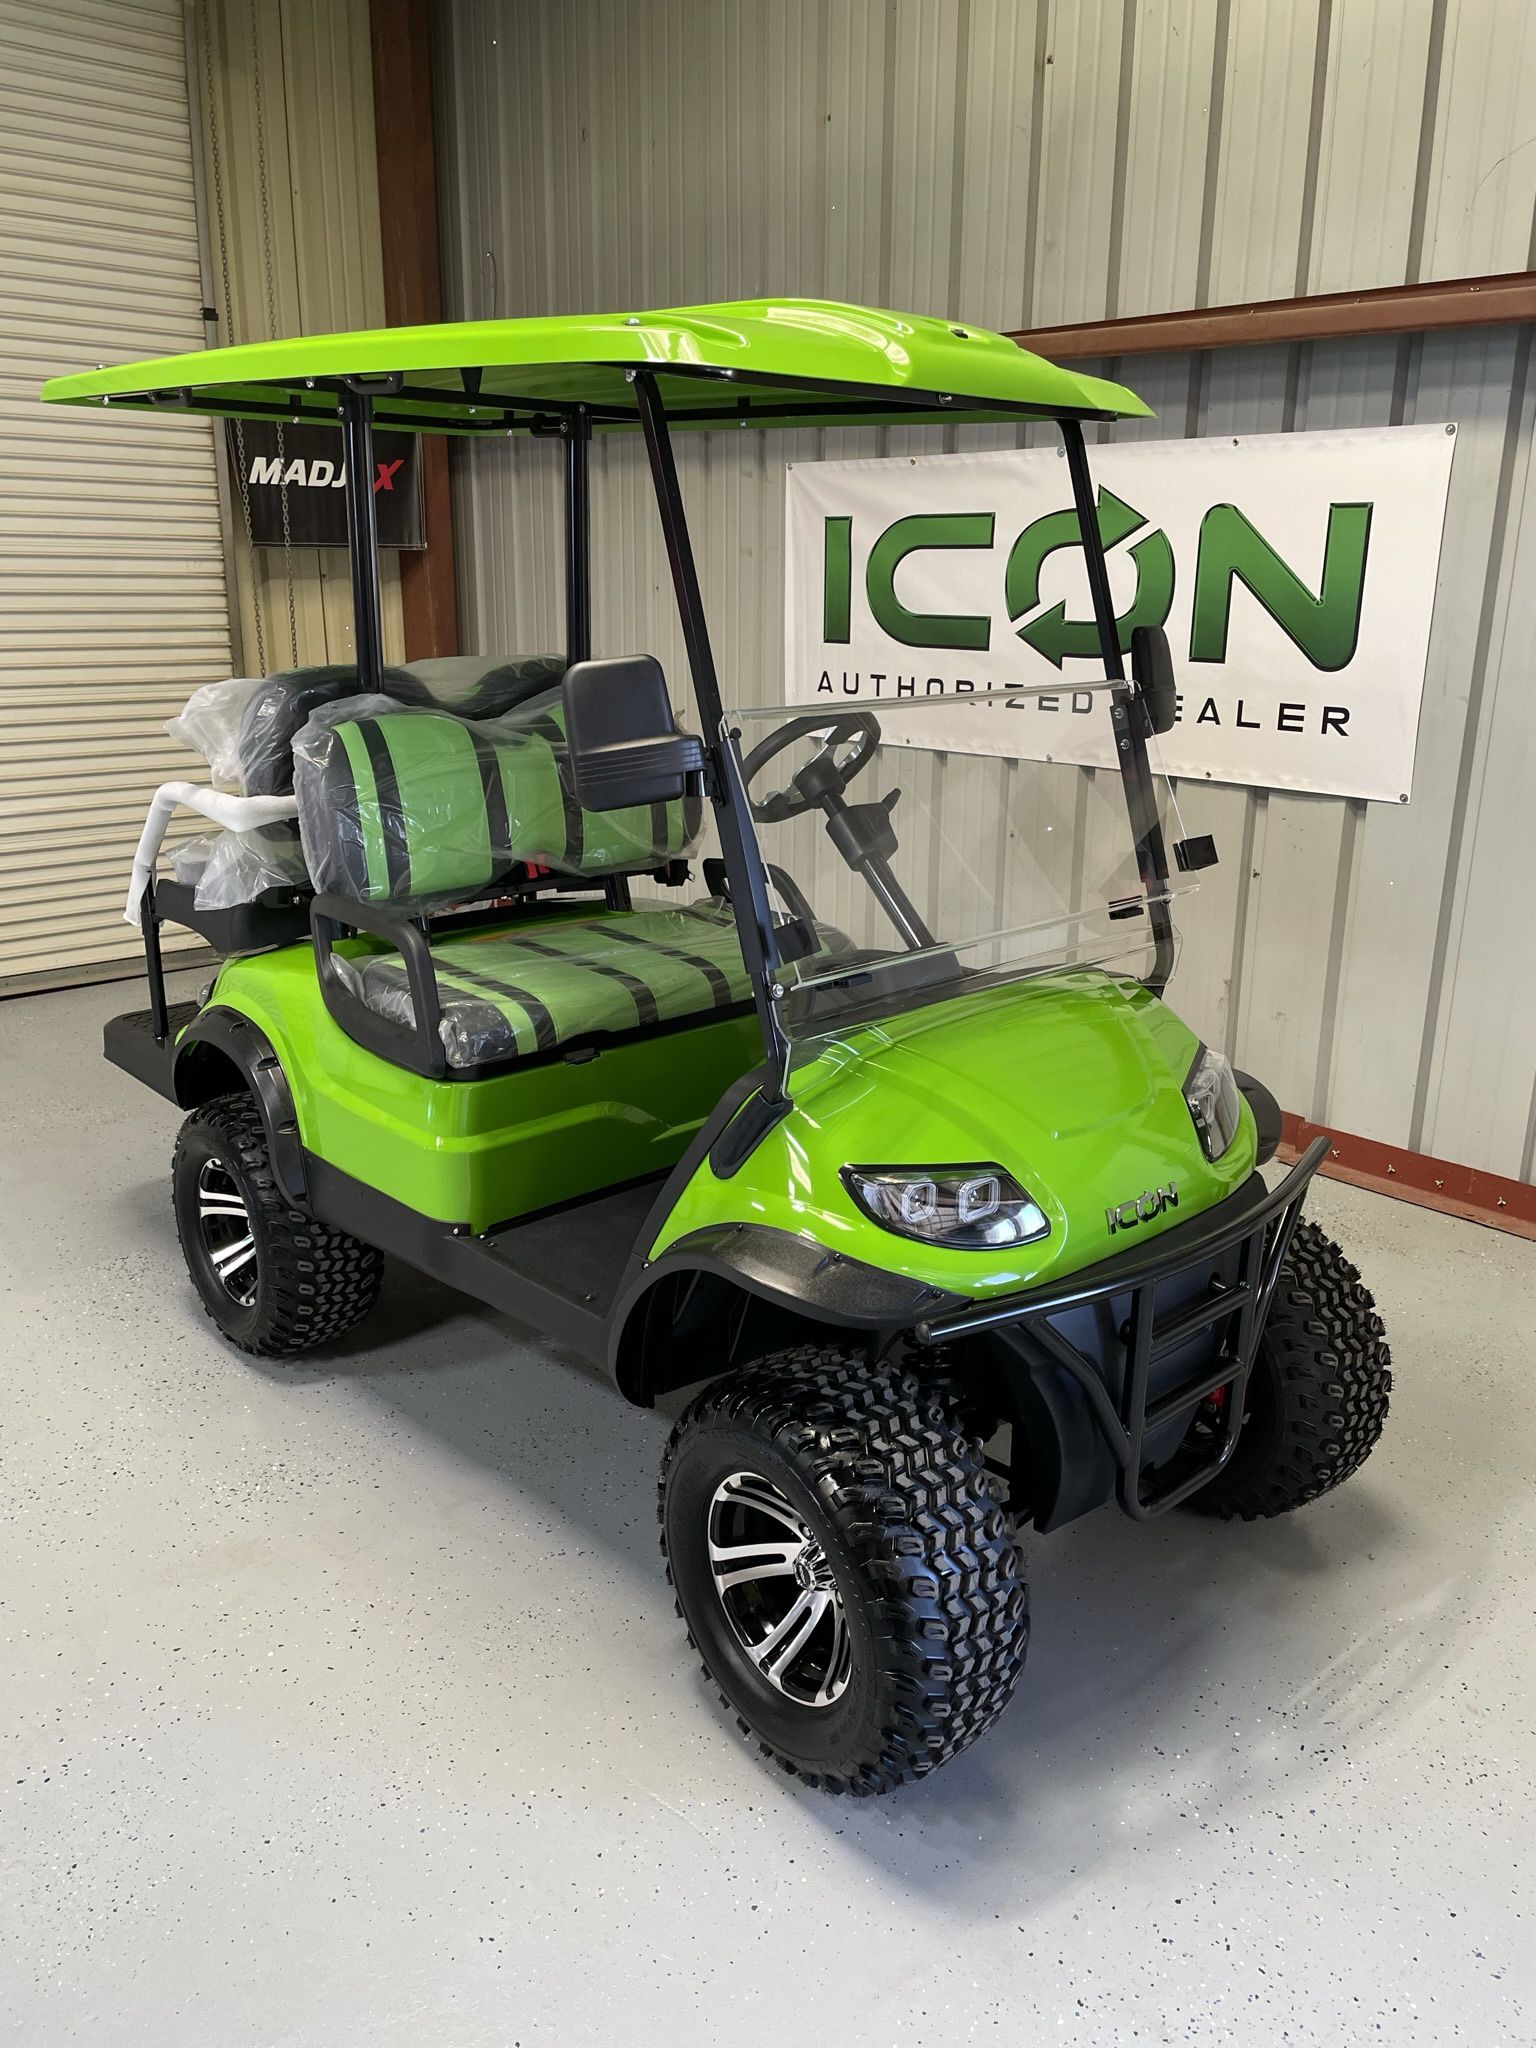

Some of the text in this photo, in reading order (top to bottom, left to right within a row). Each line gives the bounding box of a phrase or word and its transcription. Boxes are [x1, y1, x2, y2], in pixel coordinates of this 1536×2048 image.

[249, 457, 404, 493] MADJX
[823, 484, 1374, 672] ICON
[1175, 695, 1350, 737] ALER
[1105, 1181, 1179, 1235] ICON
